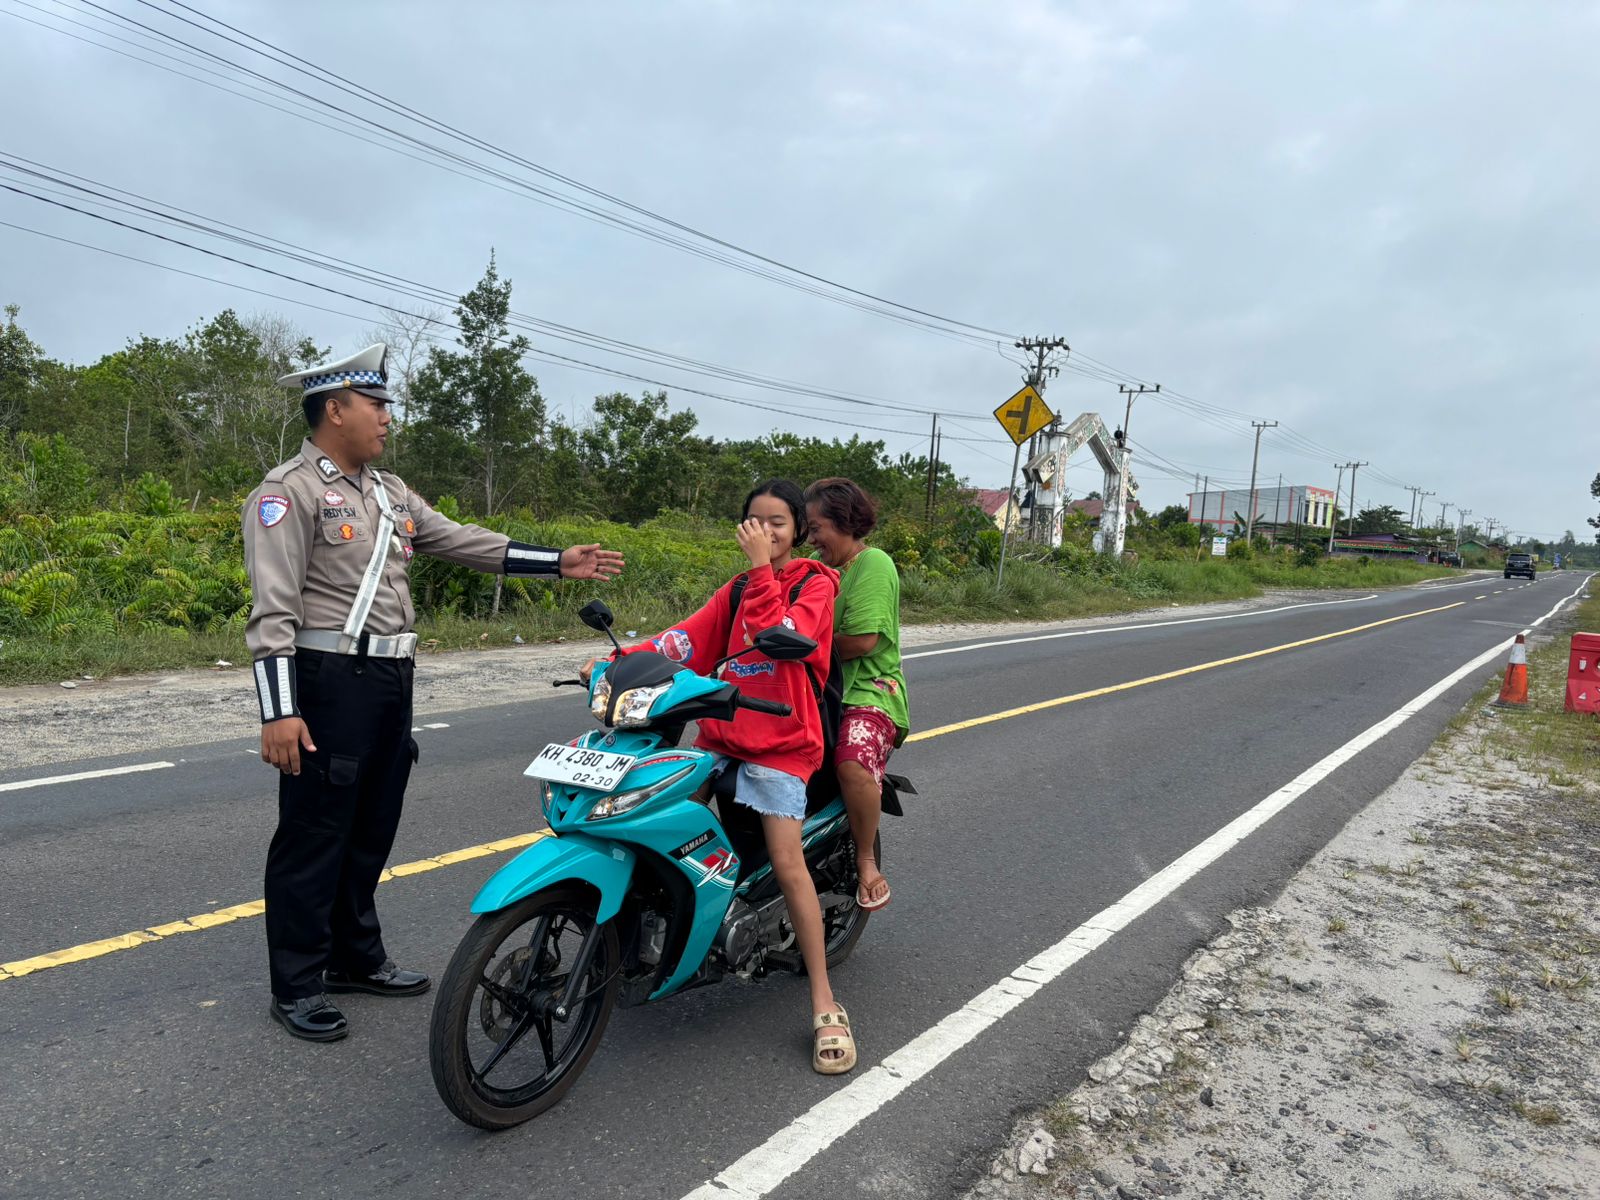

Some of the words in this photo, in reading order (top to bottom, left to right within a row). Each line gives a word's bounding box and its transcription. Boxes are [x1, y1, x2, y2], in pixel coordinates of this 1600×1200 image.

[323, 507, 343, 519] REDY
[540, 745, 565, 761] KH
[565, 750, 604, 767] 4380
[605, 757, 631, 772] JM
[680, 833, 709, 855] YAMAHA
